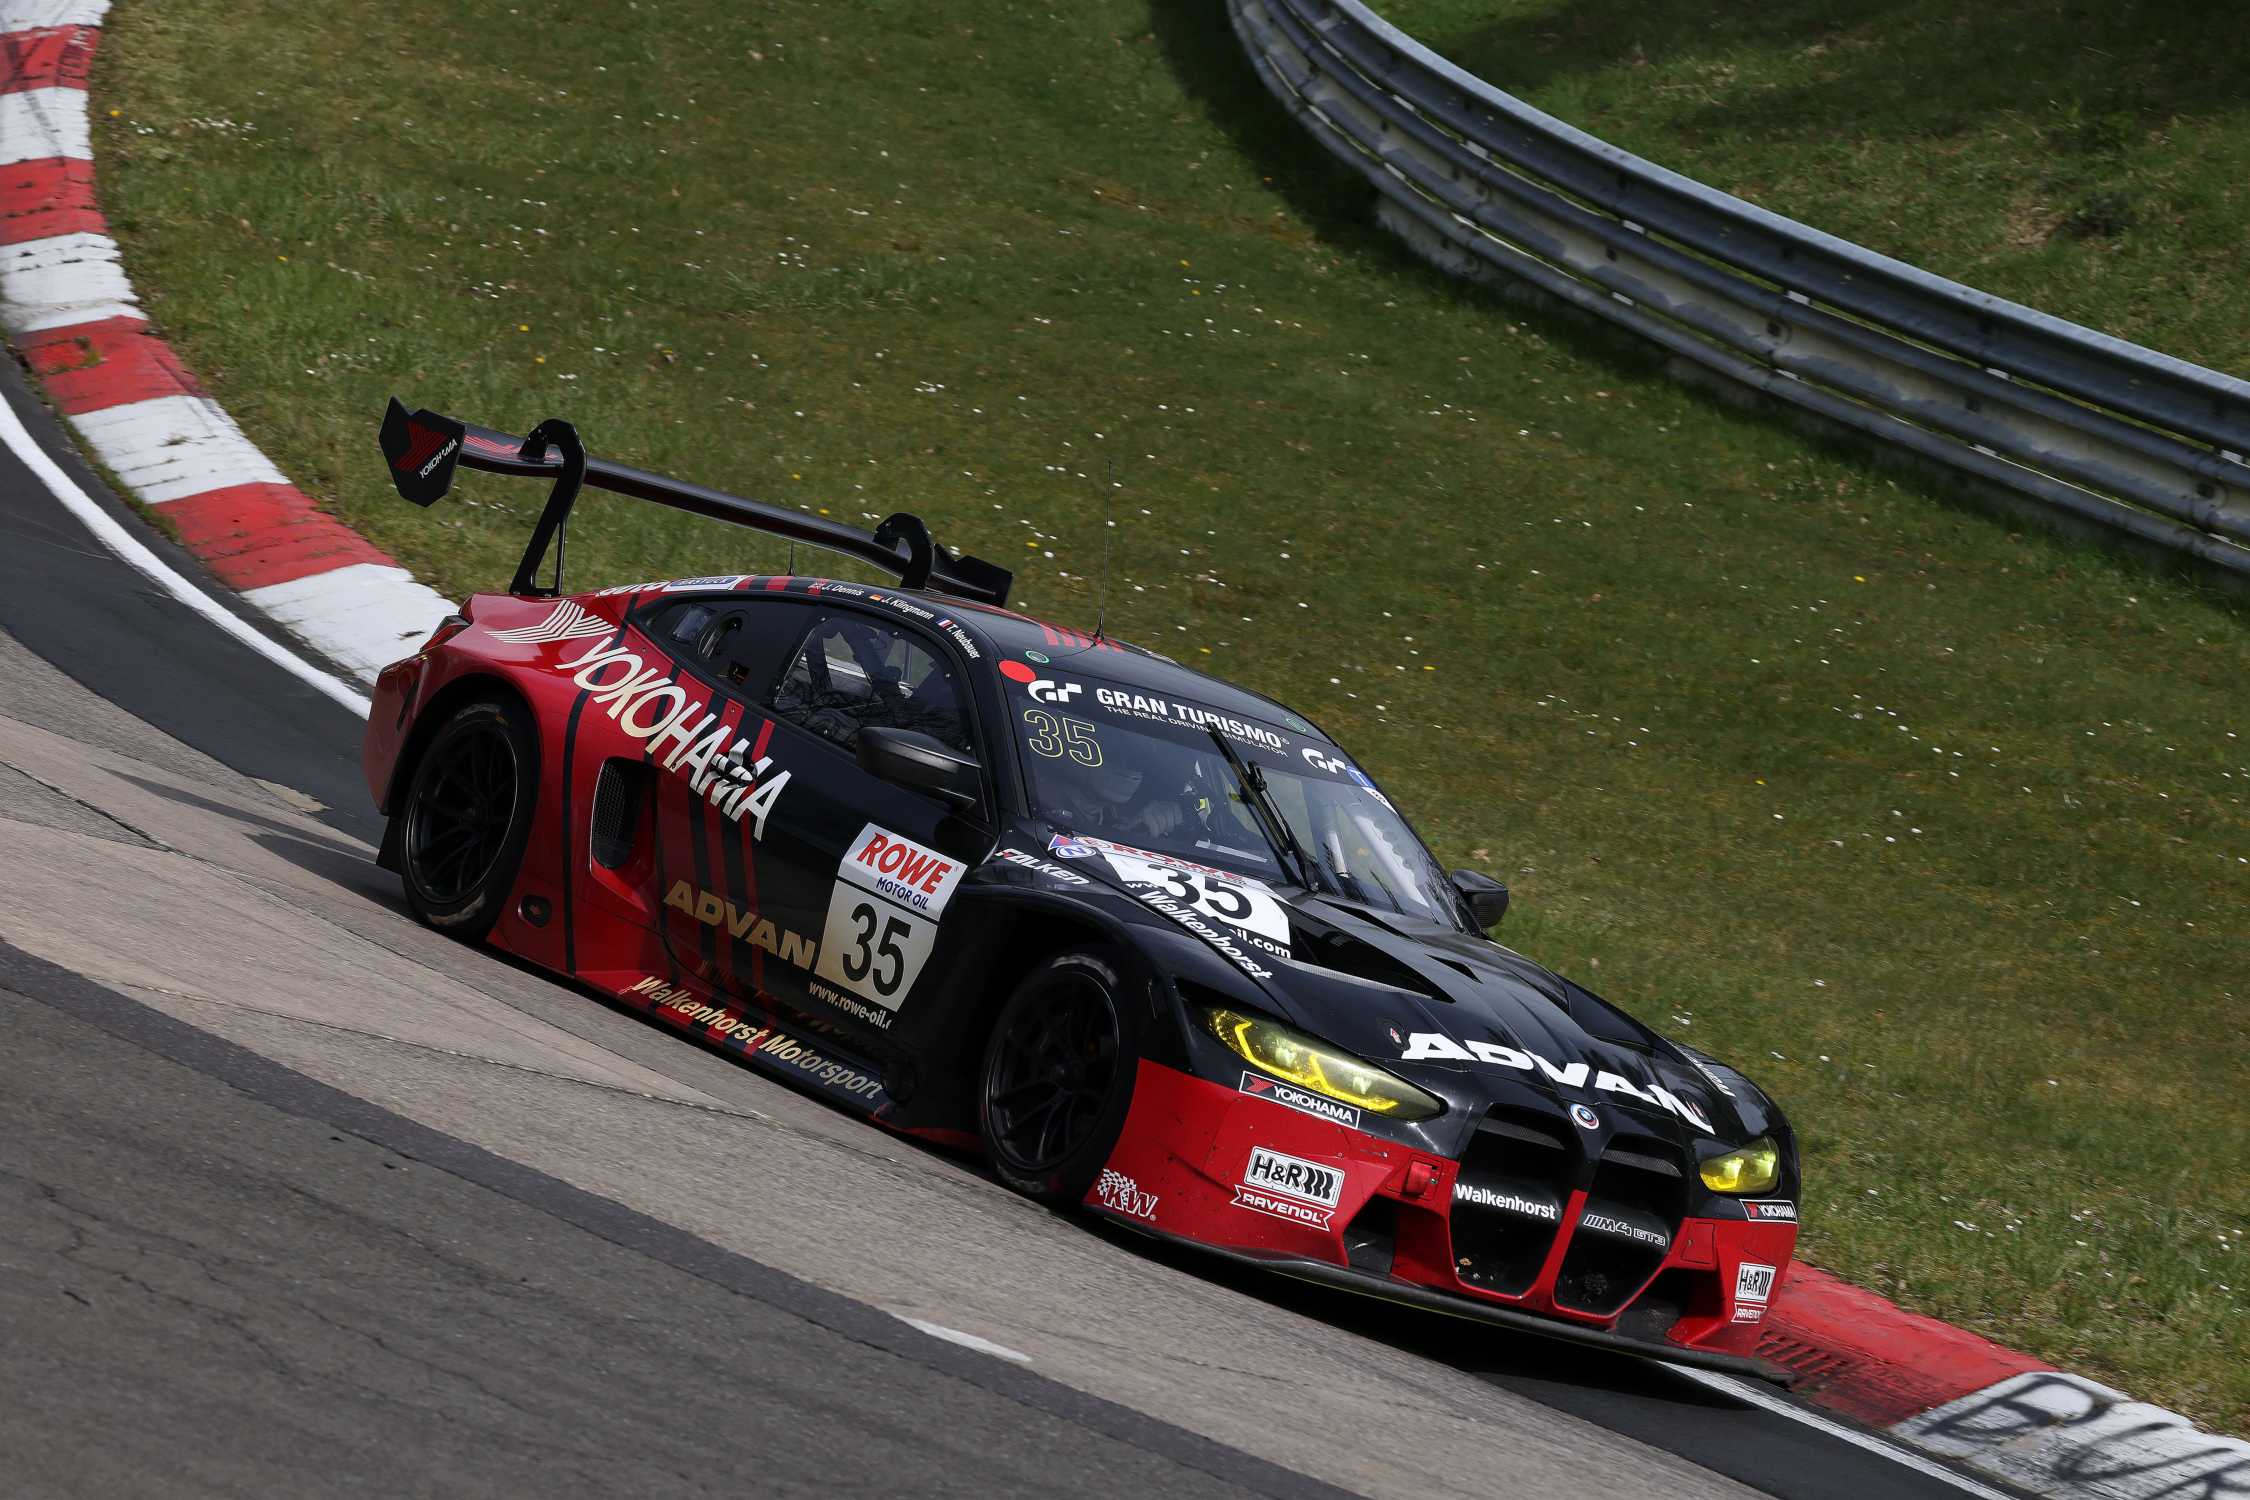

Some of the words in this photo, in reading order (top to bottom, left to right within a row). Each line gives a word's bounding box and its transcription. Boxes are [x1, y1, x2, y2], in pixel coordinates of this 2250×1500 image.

[832, 584, 865, 597] Dennis
[890, 599, 935, 620] Klingmann
[952, 627, 981, 660] Neubauer
[1096, 688, 1168, 716] GRAN
[1172, 703, 1283, 748] TURISMO
[1103, 705, 1131, 717] THE
[1132, 710, 1166, 724] REAL
[1167, 717, 1212, 734] DRIVIN
[555, 636, 792, 842] YOKOHAMA
[1023, 709, 1103, 767] 35
[856, 832, 952, 896] ROWE
[994, 848, 1090, 885] FALKEN
[876, 876, 913, 903] MOTOR
[912, 891, 929, 911] OIL
[1147, 863, 1253, 920] 35
[663, 879, 816, 971] ADVAN
[1139, 890, 1274, 980] Walkenhorst
[842, 902, 912, 998] 35
[631, 976, 767, 1044] Walkenhorst
[758, 1033, 885, 1100] Motorsport
[1402, 1032, 1715, 1135] ADVAN
[1273, 1086, 1356, 1123] YOKOHAMA
[1251, 1154, 1303, 1191] H&R
[1103, 1184, 1159, 1218] KW
[1242, 1192, 1323, 1224] RAVENOL
[1455, 1183, 1556, 1220] Walkenhorst
[1759, 1204, 1796, 1218] YOKOHAMA
[1739, 1268, 1760, 1293] H&R
